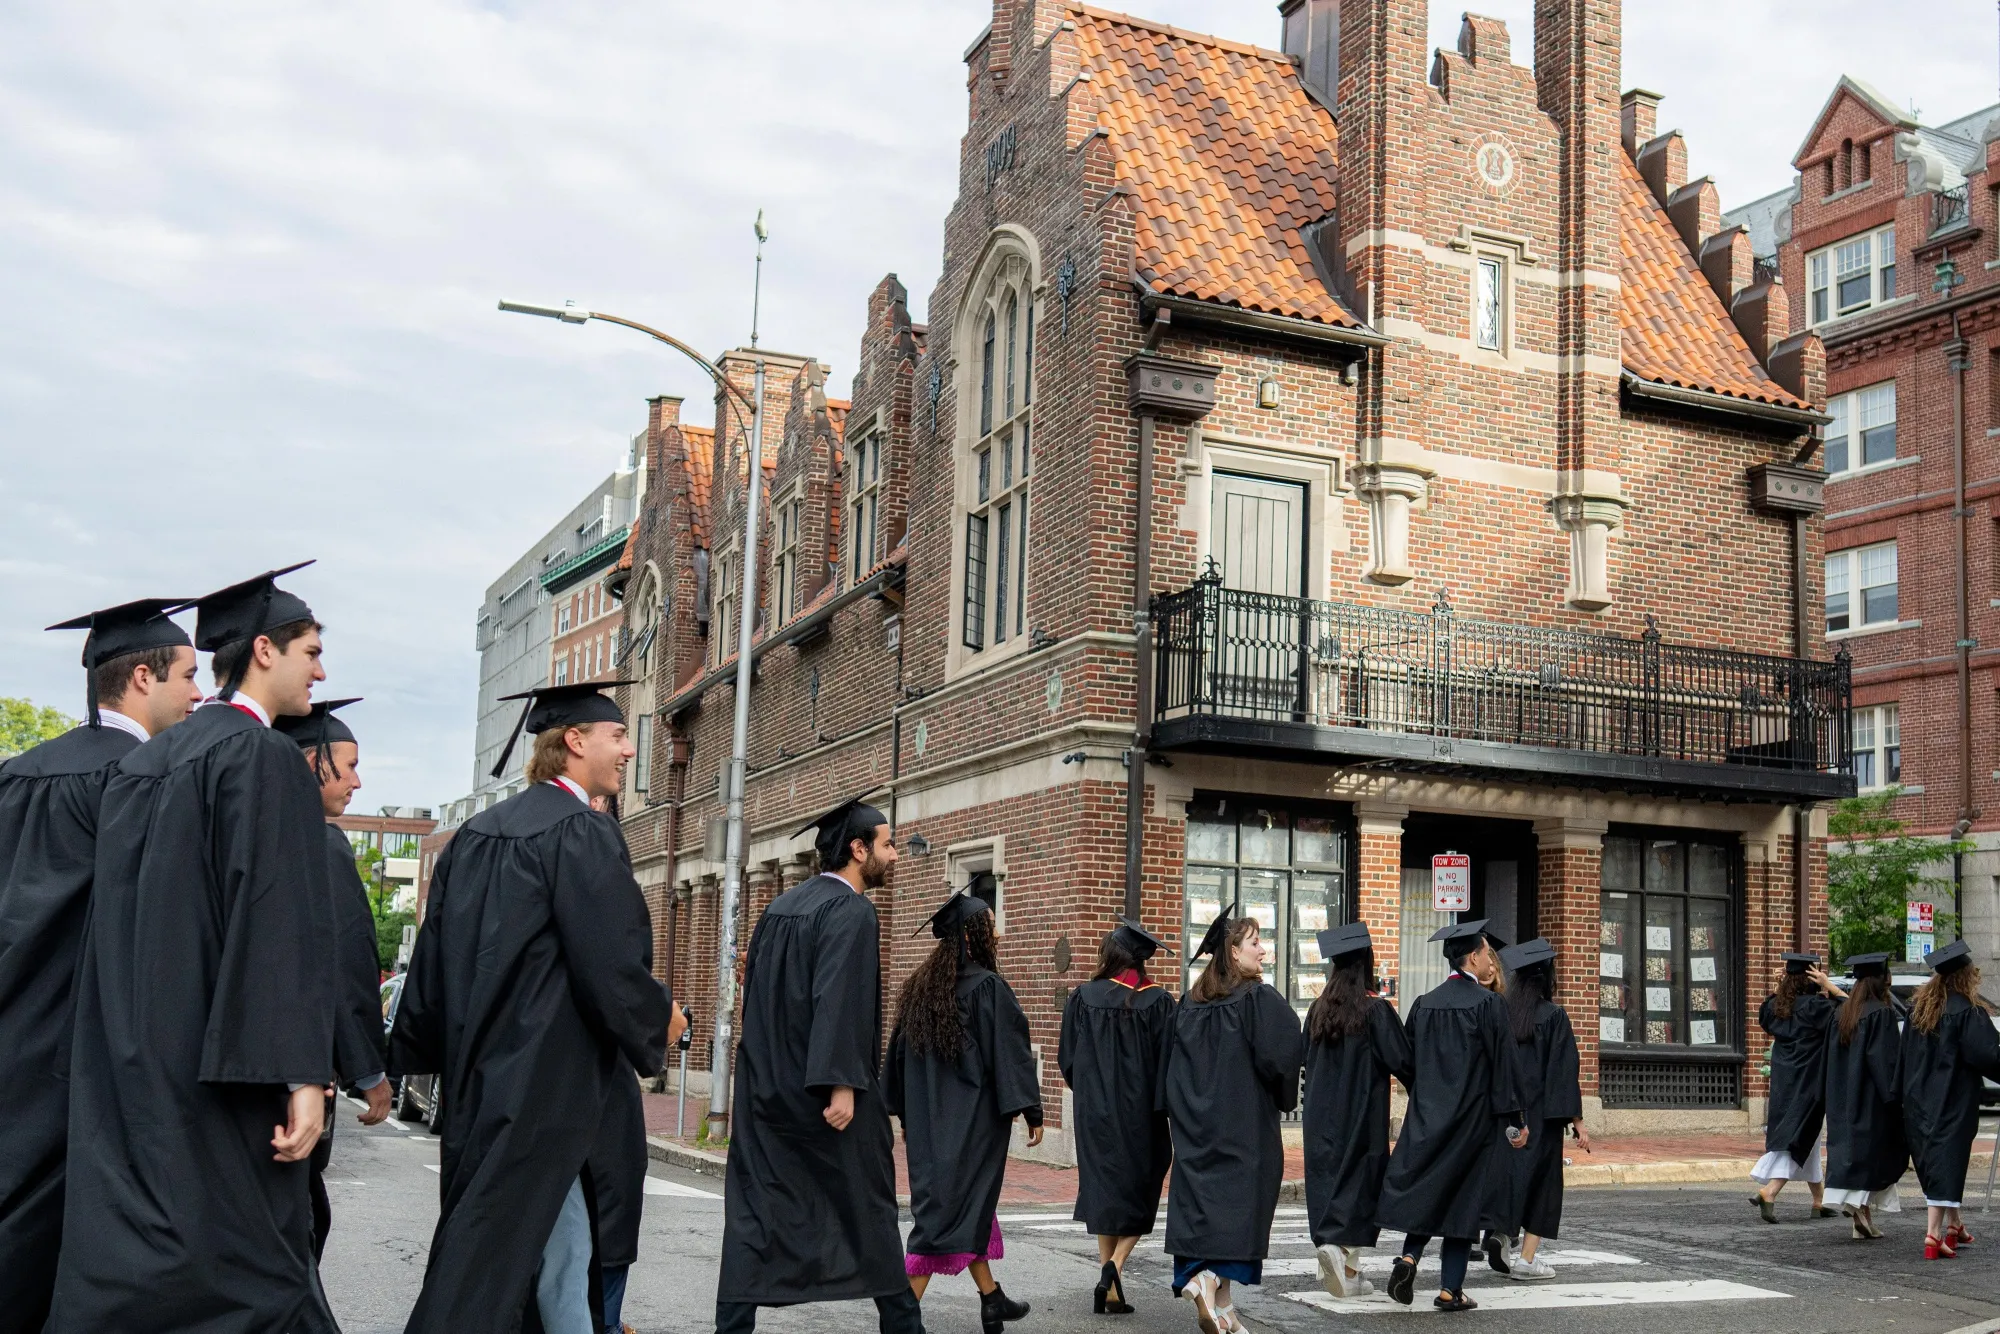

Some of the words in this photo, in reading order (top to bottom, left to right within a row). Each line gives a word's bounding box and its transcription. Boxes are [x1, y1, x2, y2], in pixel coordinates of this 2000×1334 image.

[986, 122, 1015, 193] 1909
[1435, 857, 1448, 866] TOW
[1450, 857, 1468, 866] ZONE
[1445, 872, 1457, 880] NO
